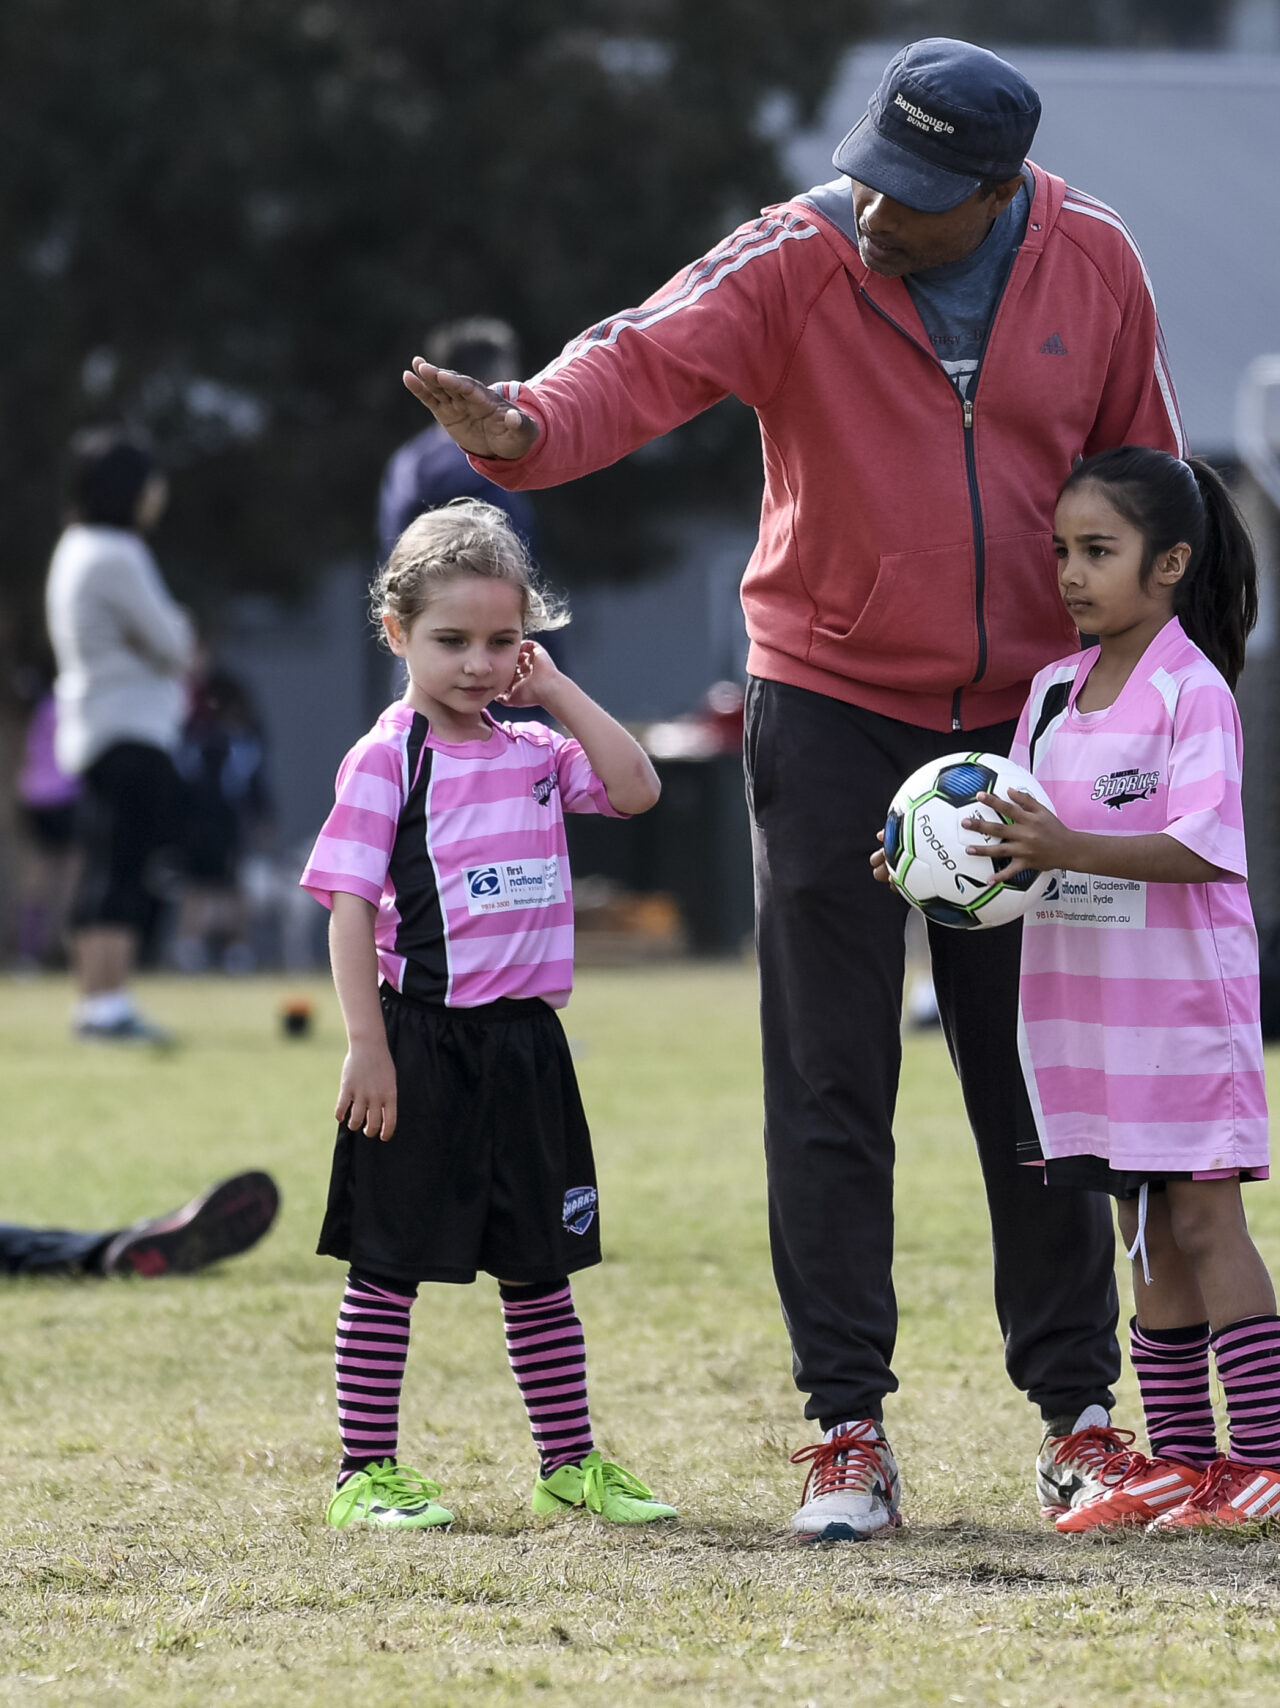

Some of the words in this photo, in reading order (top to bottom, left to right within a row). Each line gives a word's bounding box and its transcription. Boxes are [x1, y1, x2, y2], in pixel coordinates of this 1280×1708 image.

[906, 115, 930, 132] DUNES
[1091, 771, 1160, 800] SHARKS
[917, 814, 957, 871] deploy
[506, 865, 524, 876] first
[509, 875, 543, 887] national
[1093, 881, 1140, 891] Gladesville
[1093, 895, 1114, 905] Ryde
[1036, 910, 1055, 920] 9816
